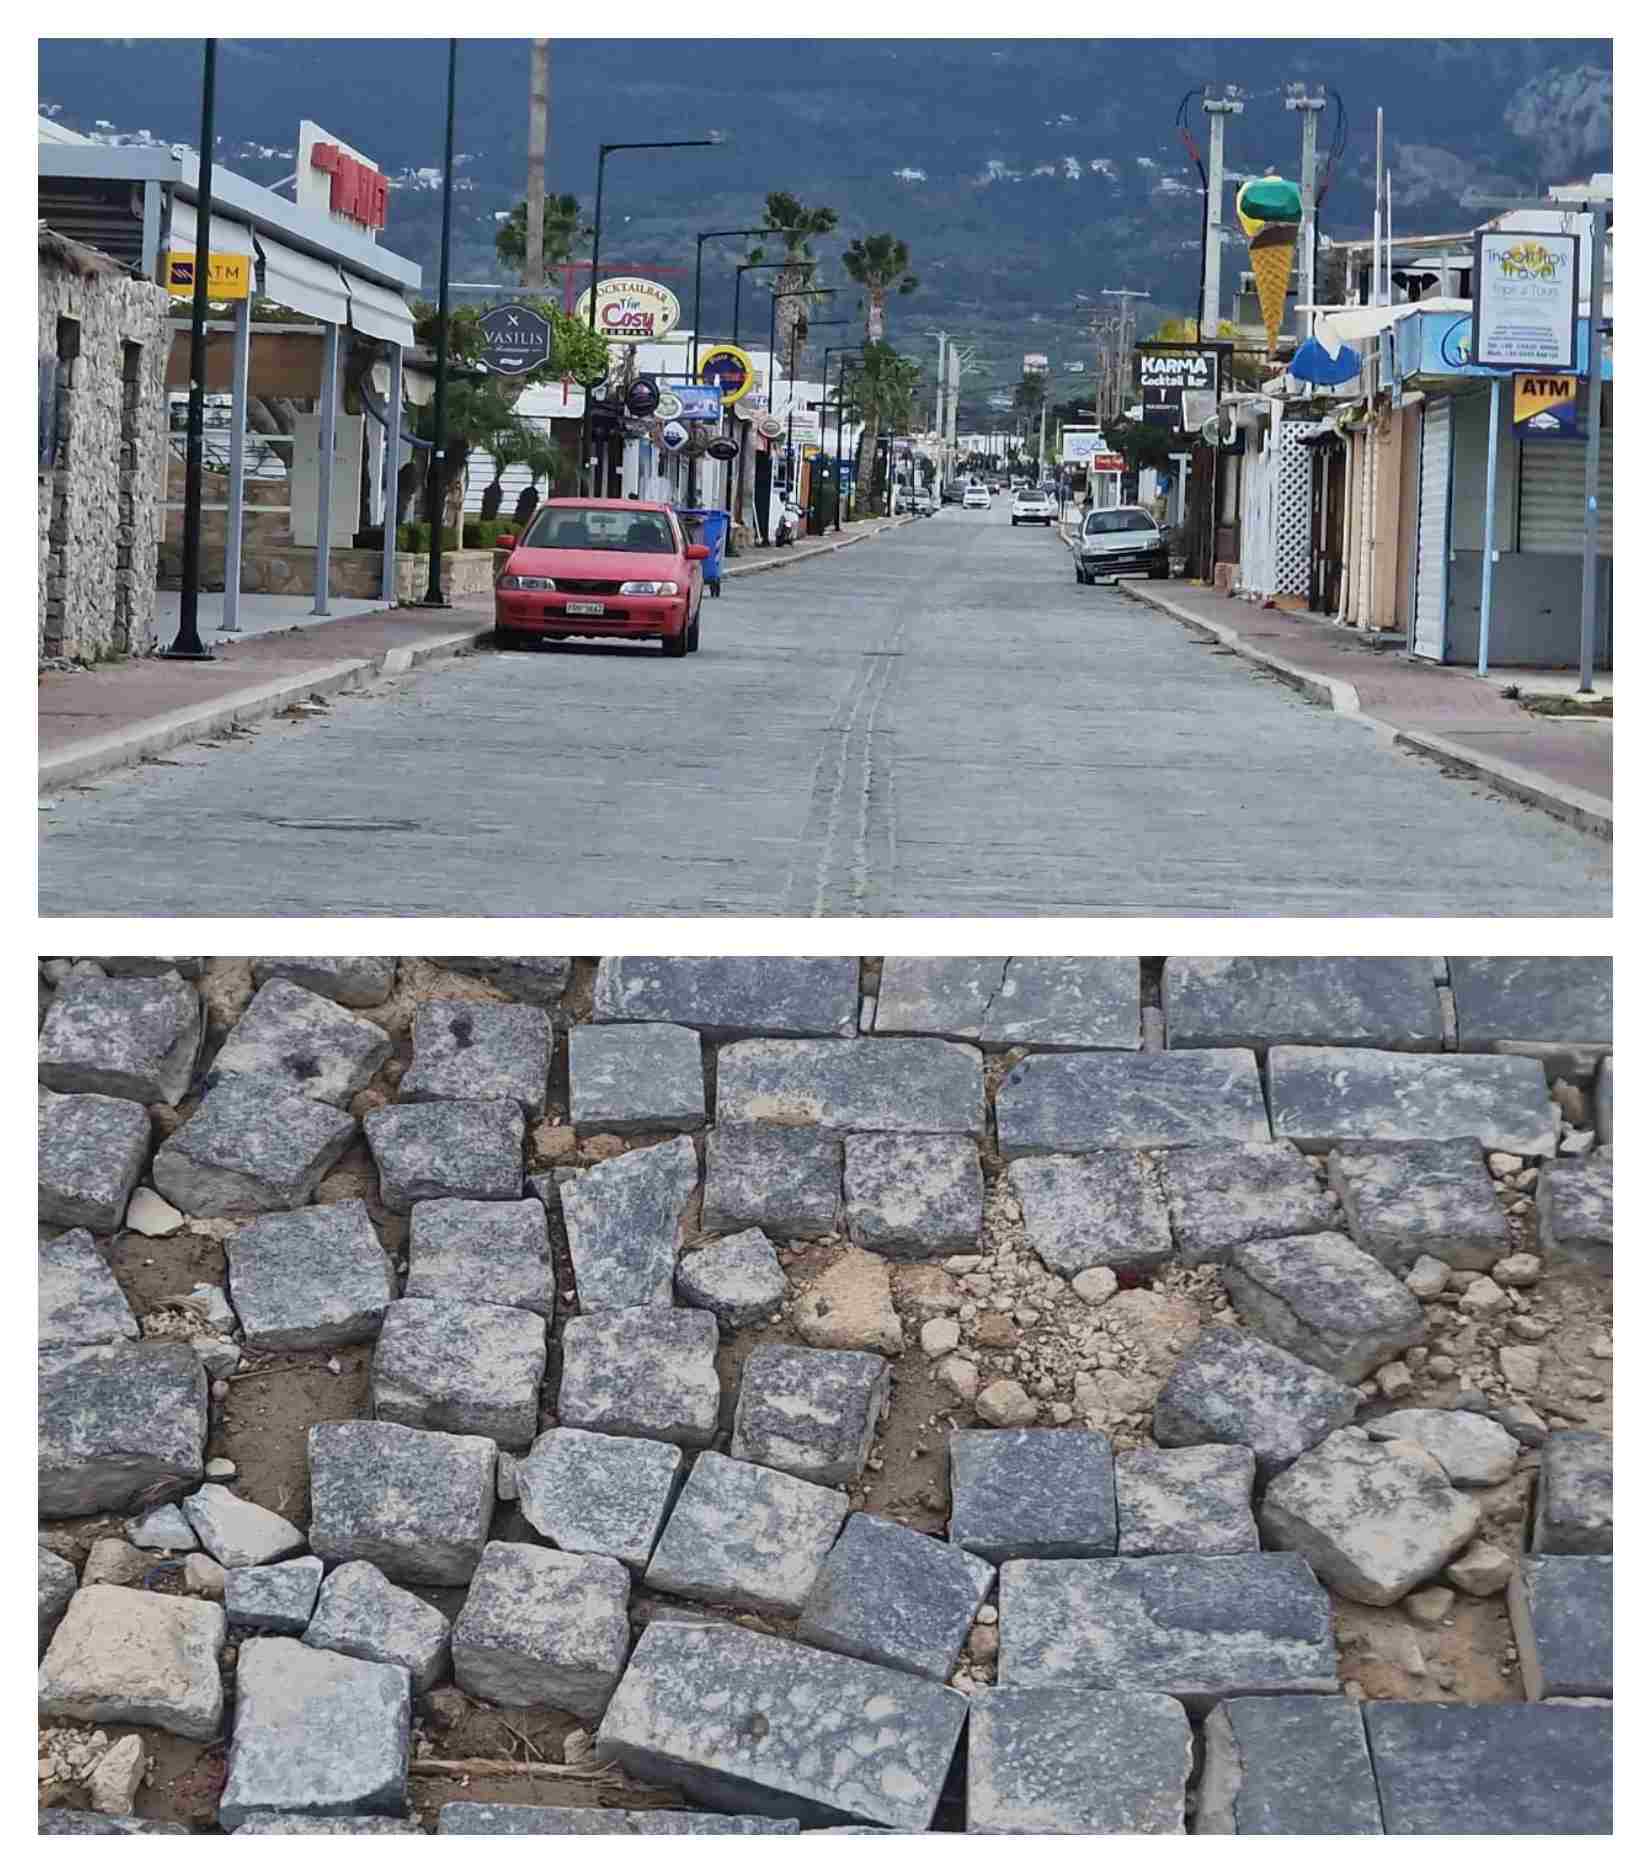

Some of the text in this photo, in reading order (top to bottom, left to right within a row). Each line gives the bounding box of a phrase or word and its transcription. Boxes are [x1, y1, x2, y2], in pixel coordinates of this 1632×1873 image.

[596, 282, 668, 302] OCKTAILBAR
[602, 303, 654, 329] Cosy
[483, 331, 544, 345] VASILIS
[1141, 357, 1208, 375] KARMA
[1141, 374, 1208, 387] Cocktail Bar
[1522, 379, 1569, 396] ATM
